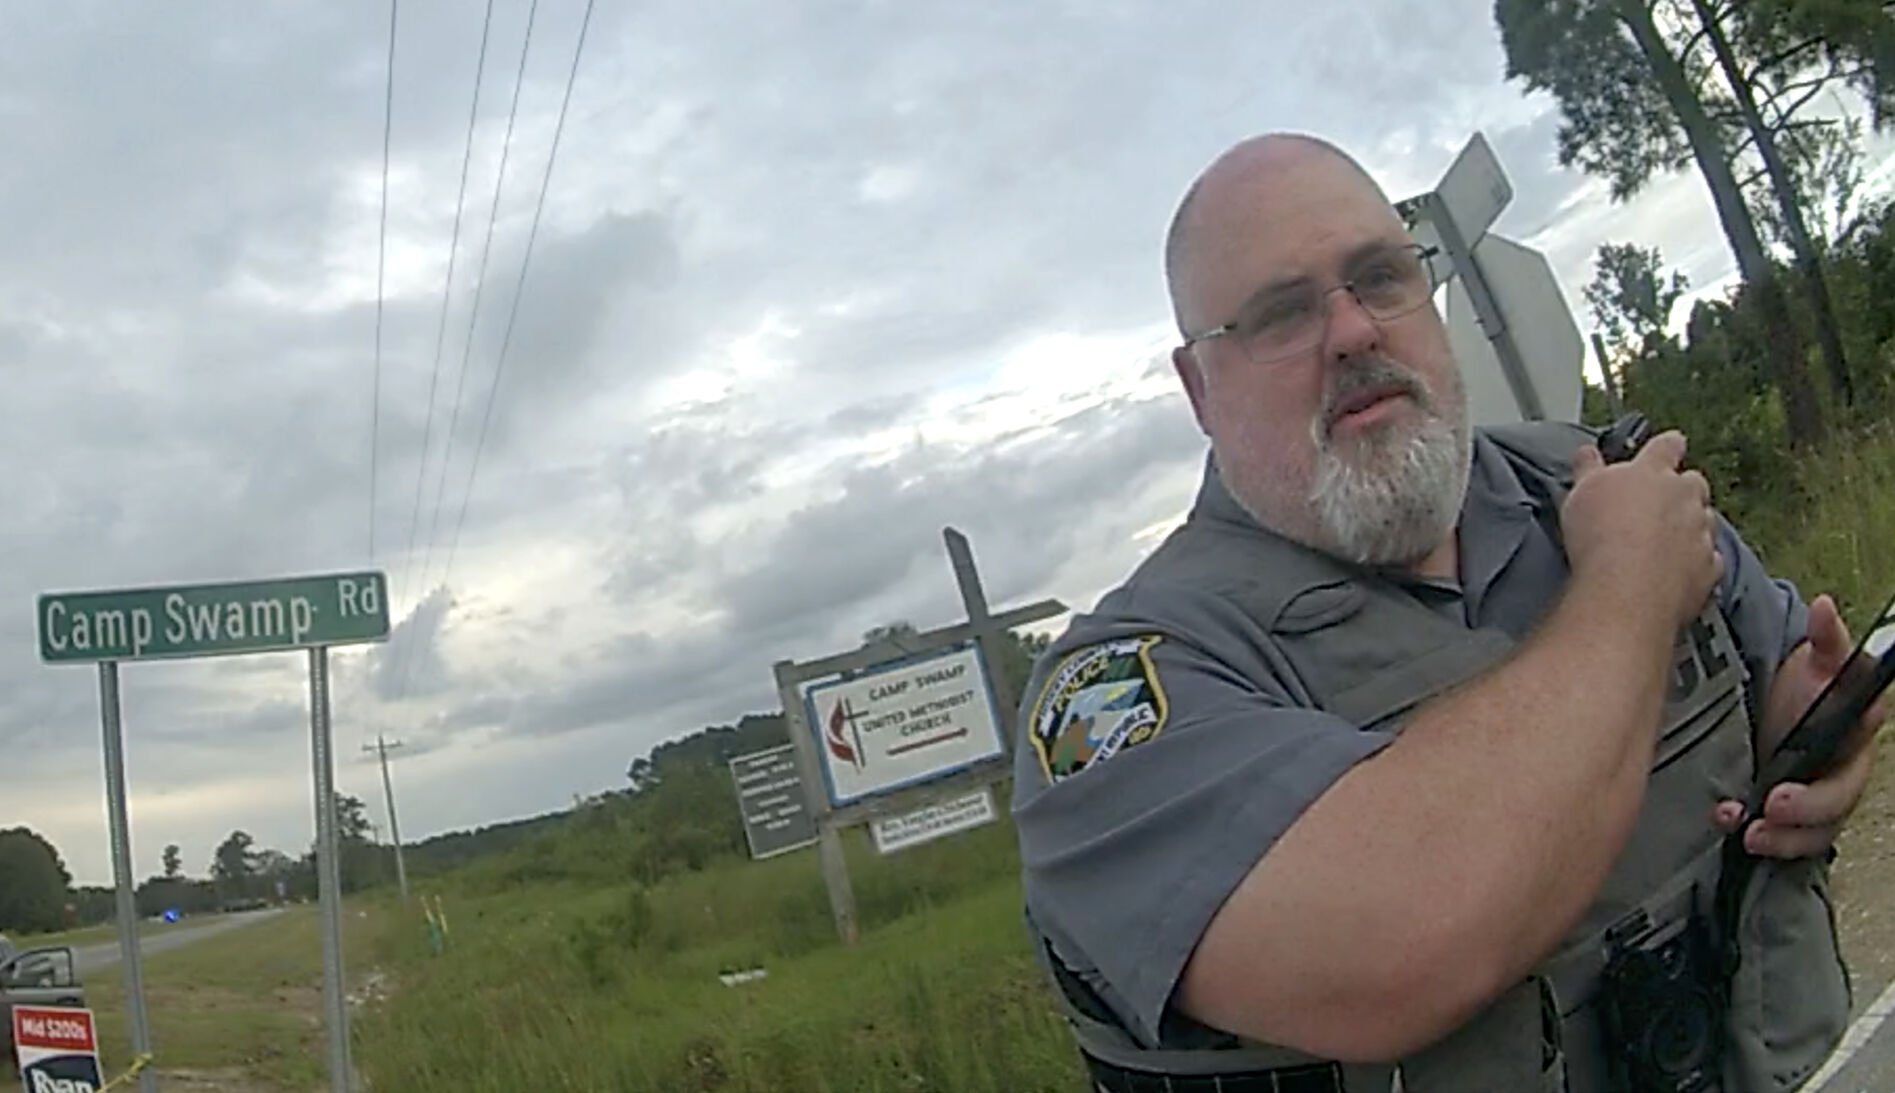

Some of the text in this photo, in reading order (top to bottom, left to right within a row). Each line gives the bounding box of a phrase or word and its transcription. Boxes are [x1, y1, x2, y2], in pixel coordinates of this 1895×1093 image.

[47, 577, 379, 657] Camp Swamp Rd
[868, 664, 966, 701] CAMP SWAMP
[1054, 656, 1109, 712] POLICE
[862, 690, 974, 733] UNITED METHODIST
[901, 713, 952, 737] CHURCH
